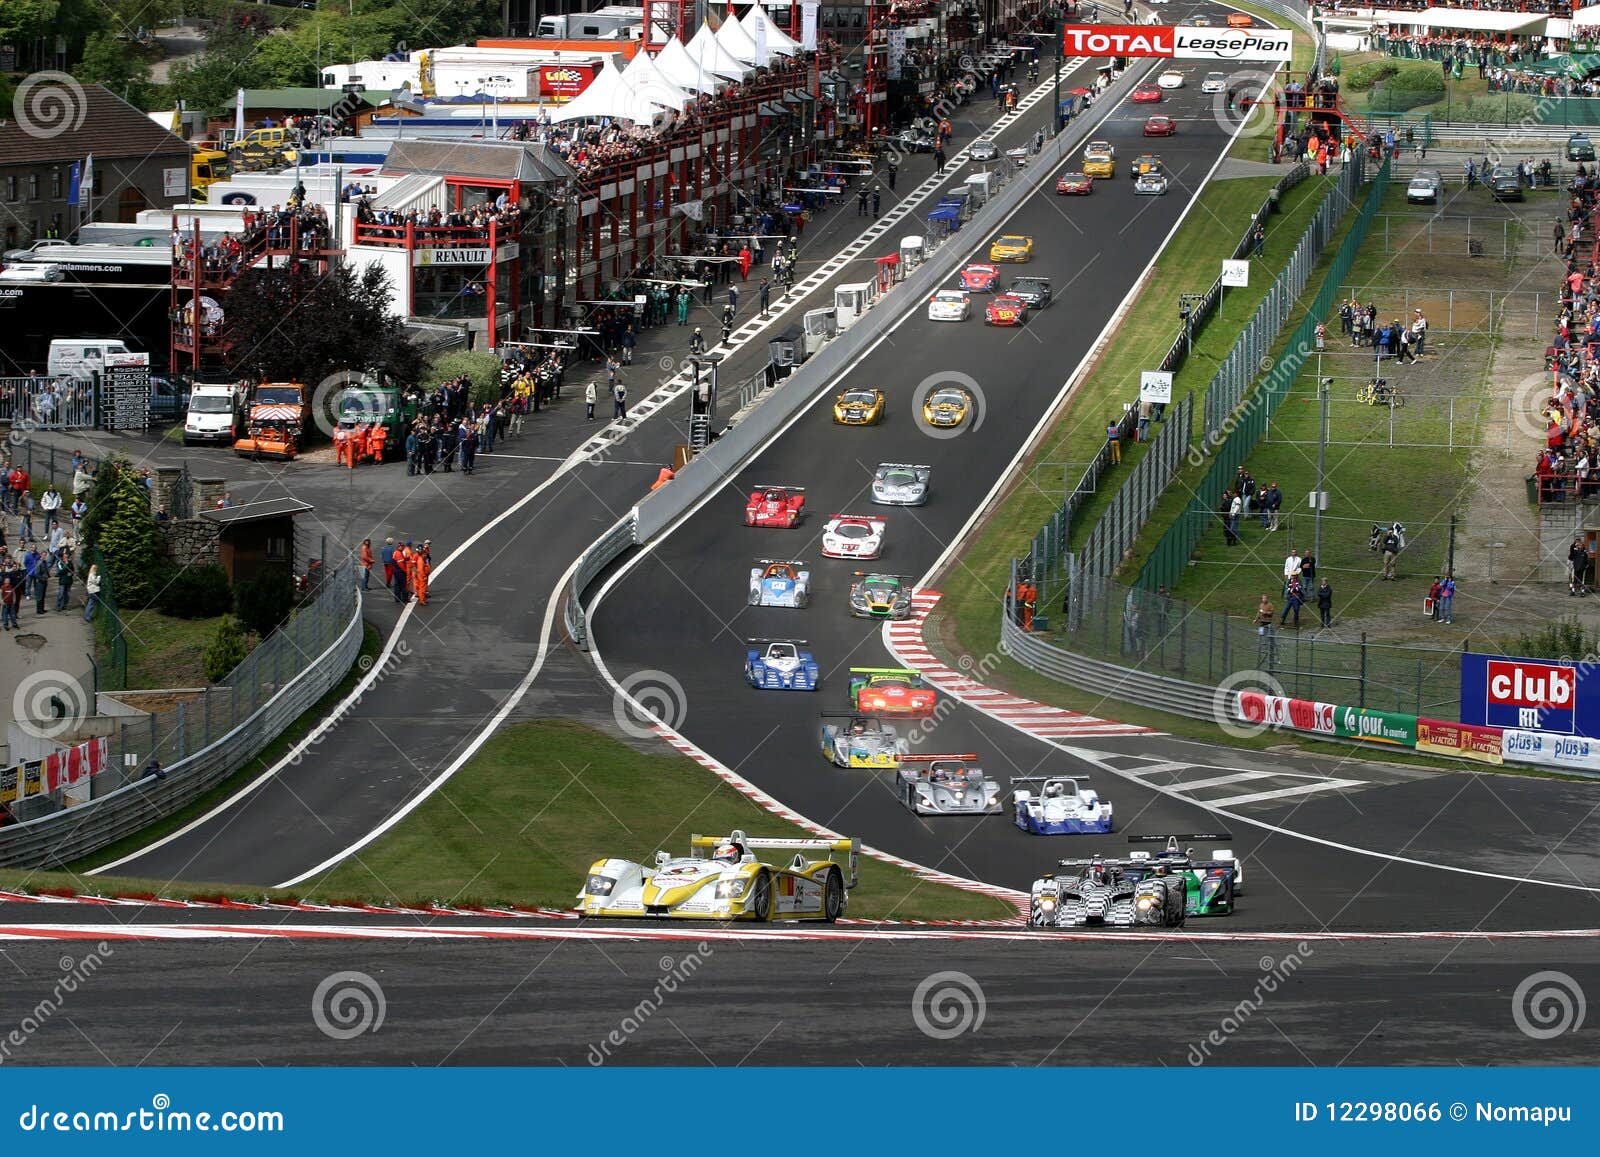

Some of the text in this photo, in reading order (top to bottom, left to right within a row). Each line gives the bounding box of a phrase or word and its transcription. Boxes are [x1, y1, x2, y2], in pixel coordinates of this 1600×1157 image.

[1067, 29, 1172, 53] TOTAL
[1177, 35, 1288, 52] LeasePlan
[435, 250, 486, 262] RENAULT
[1492, 668, 1570, 704] club
[1344, 707, 1356, 731] le
[1358, 709, 1383, 736] jour
[1519, 707, 1541, 728] RTL
[1507, 733, 1532, 752] plus
[1554, 738, 1578, 758] plus
